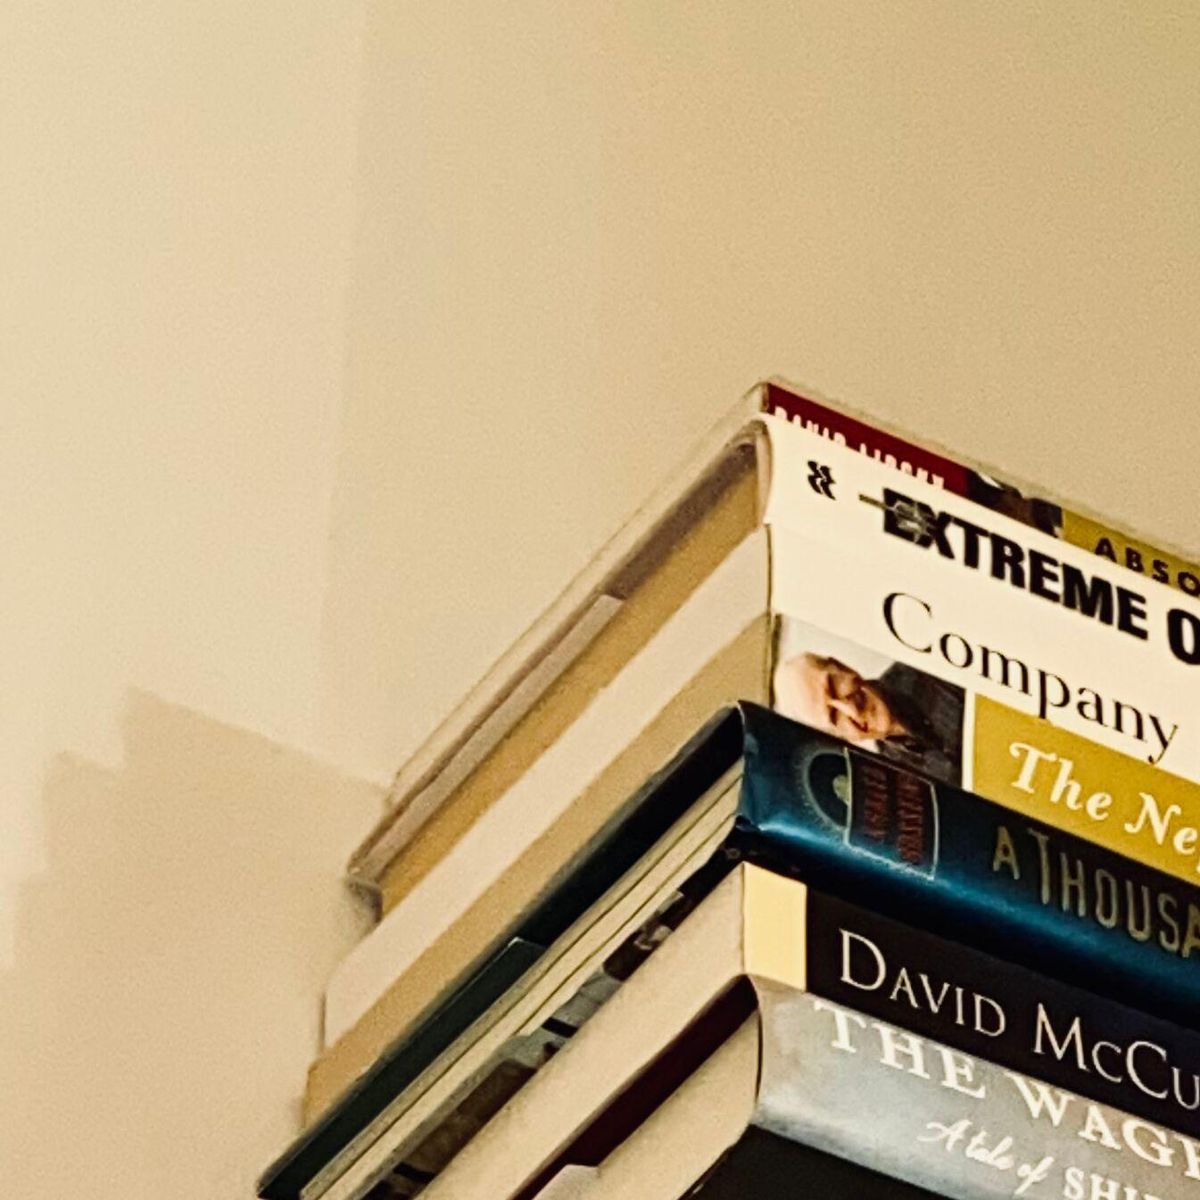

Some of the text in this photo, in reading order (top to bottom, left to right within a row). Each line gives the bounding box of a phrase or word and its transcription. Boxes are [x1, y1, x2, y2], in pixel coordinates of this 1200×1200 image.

[883, 487, 1149, 642] EXTREME
[883, 592, 1179, 765] Company
[1008, 741, 1113, 822] The
[992, 825, 1021, 881] A
[838, 927, 1007, 1038] DAVID
[813, 999, 987, 1100] THE
[1012, 1156, 1056, 1196] of
